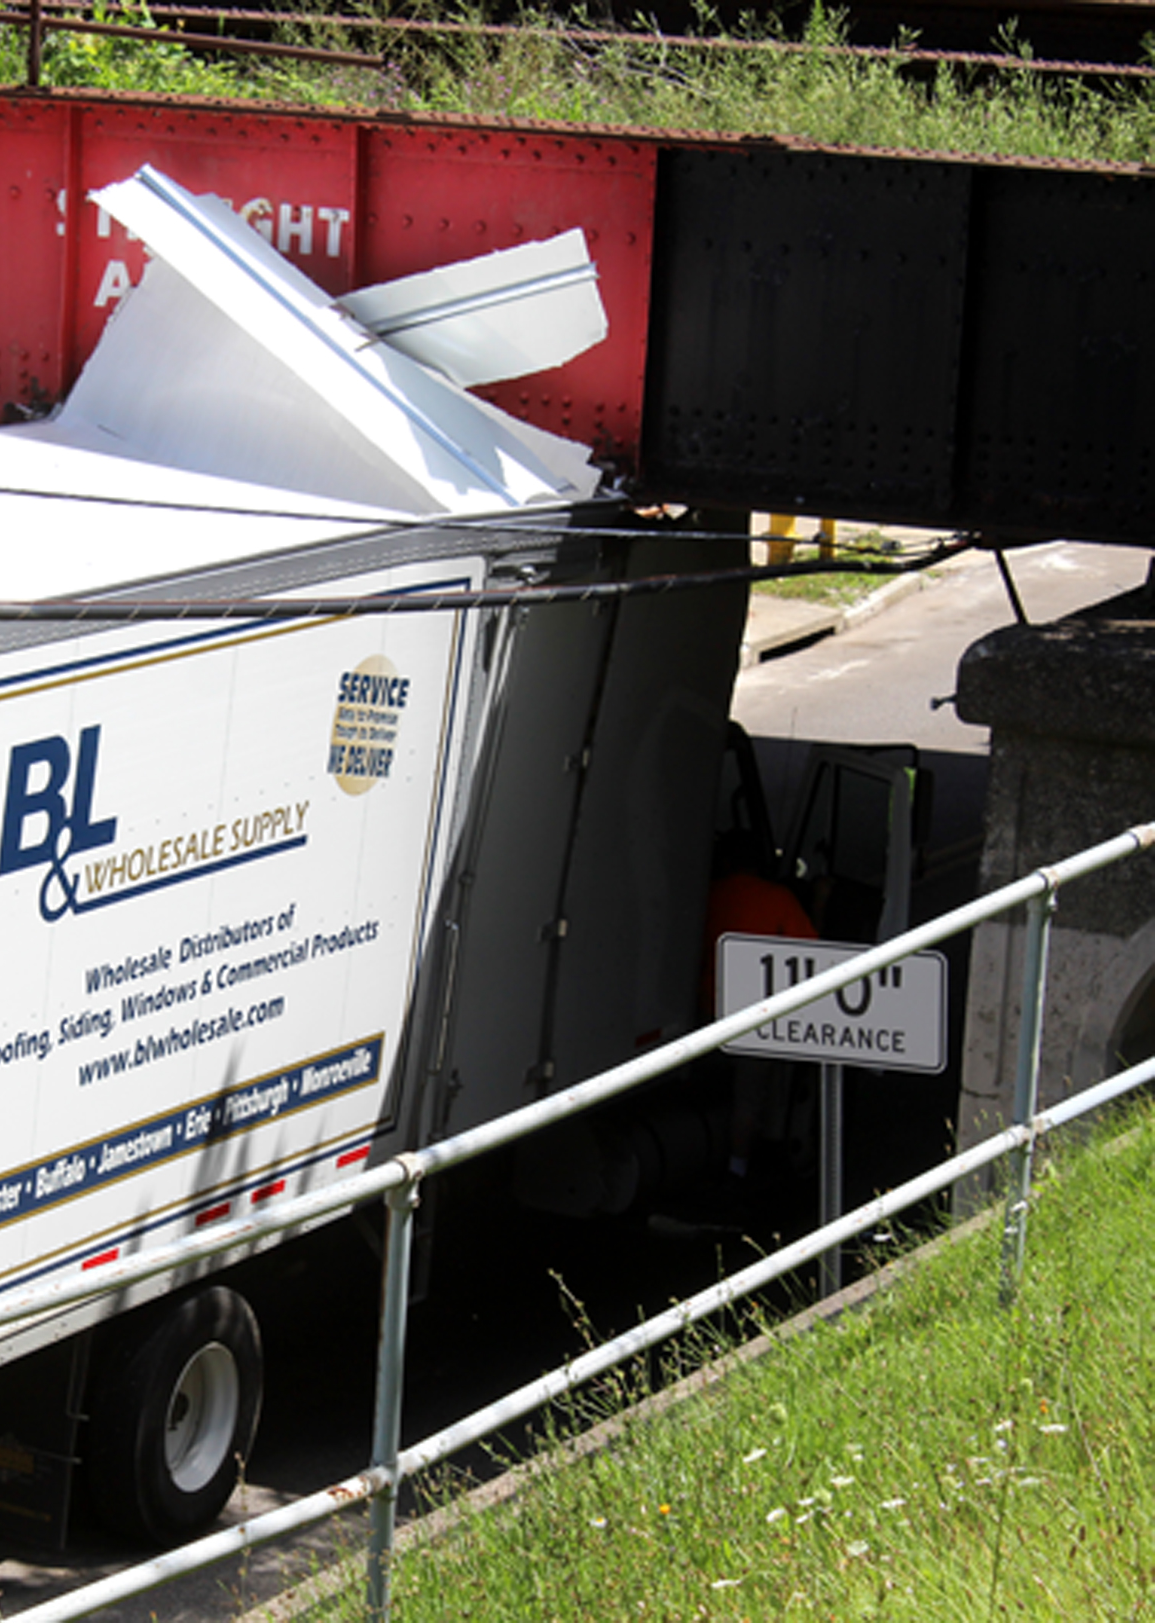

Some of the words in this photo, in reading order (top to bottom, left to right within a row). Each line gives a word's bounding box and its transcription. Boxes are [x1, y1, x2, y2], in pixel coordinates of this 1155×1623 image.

[338, 671, 410, 708] SERVICE
[327, 745, 345, 774] WE
[346, 745, 393, 778] DELIVER
[85, 824, 226, 892] WHOLESALE
[231, 800, 310, 854] SUPPLY
[58, 1004, 115, 1044] Siding,
[121, 976, 197, 1024] Windows
[201, 971, 213, 995] &
[217, 939, 309, 990] Commercial
[311, 920, 379, 958] Products
[85, 946, 172, 994] Wholesale
[180, 917, 274, 964] Distributors
[278, 903, 296, 930] of
[78, 996, 285, 1087] www.blwholesale.com
[756, 1018, 906, 1053] CLEARANCE
[35, 1156, 86, 1199] Buffalo
[98, 1123, 173, 1174] Jamestown
[185, 1106, 212, 1141] Erie
[224, 1078, 289, 1127] Pittsburgh
[300, 1047, 372, 1098] Monroeville
